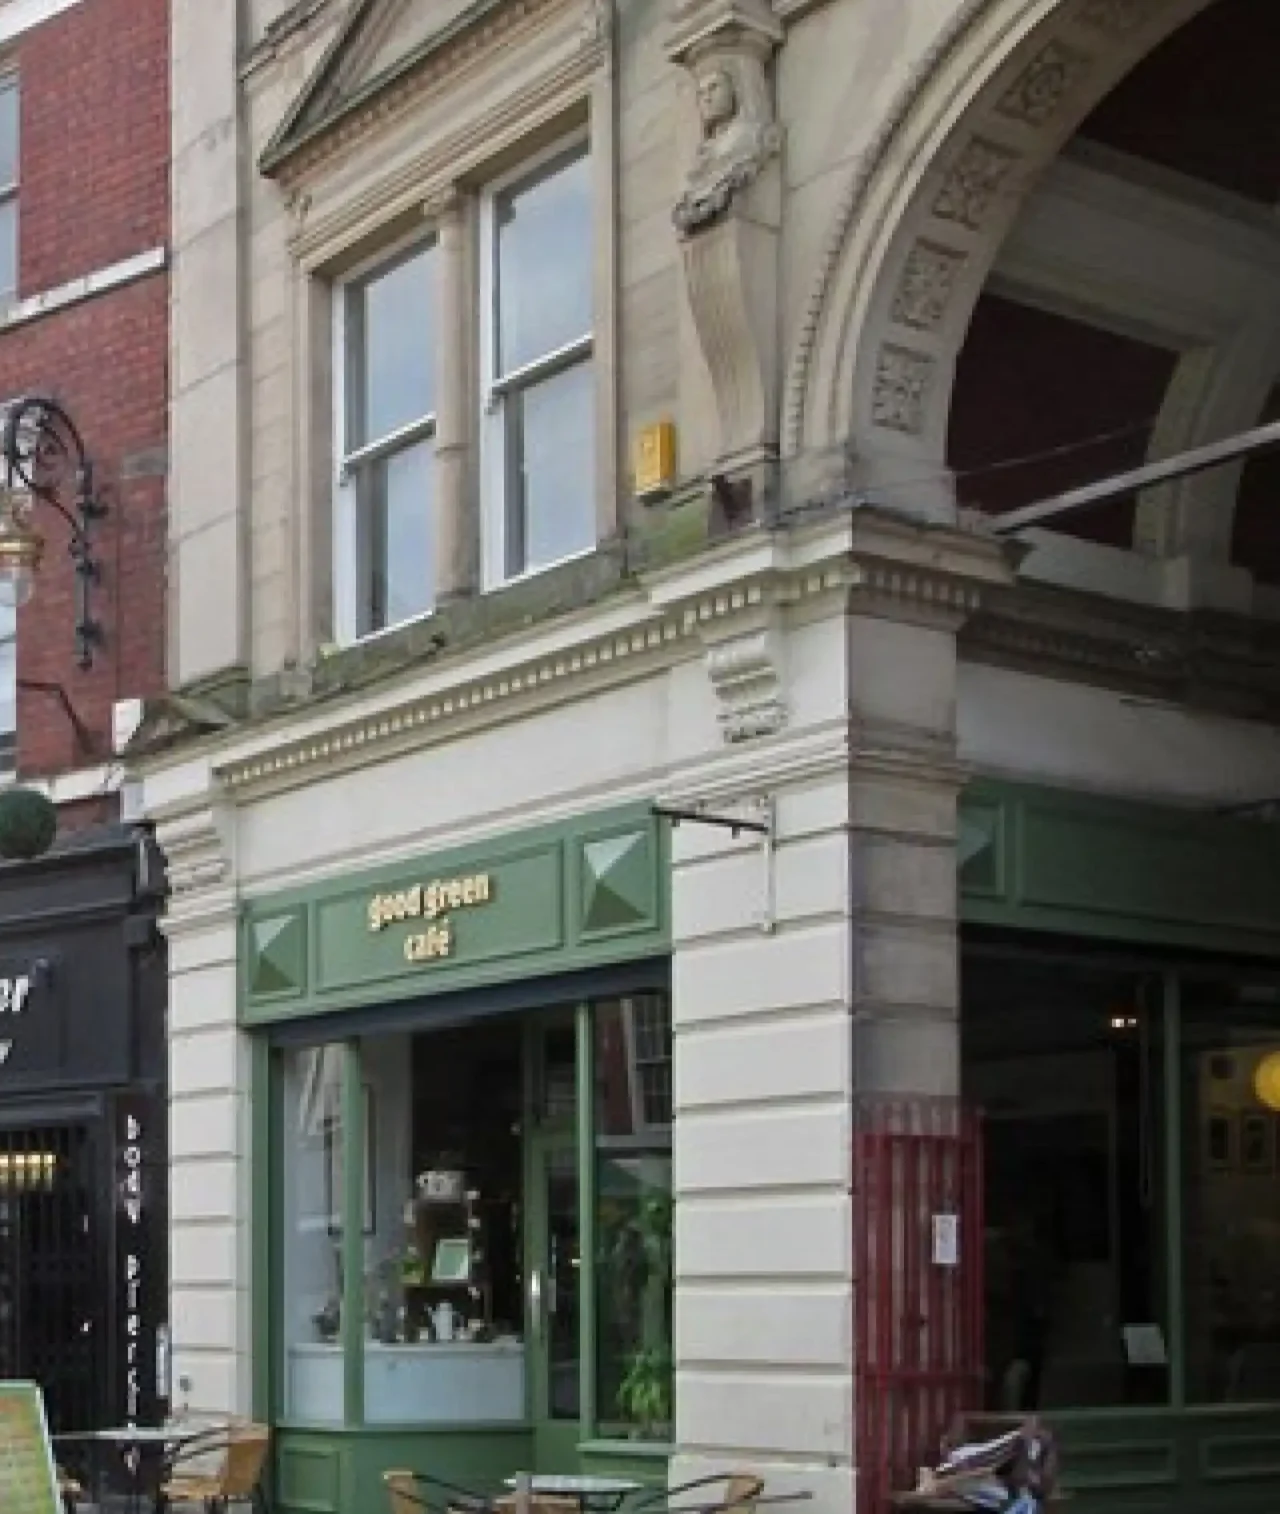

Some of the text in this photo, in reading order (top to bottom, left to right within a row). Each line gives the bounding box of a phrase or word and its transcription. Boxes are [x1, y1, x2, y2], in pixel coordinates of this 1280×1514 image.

[368, 874, 489, 931] good green
[403, 917, 449, 960] café
